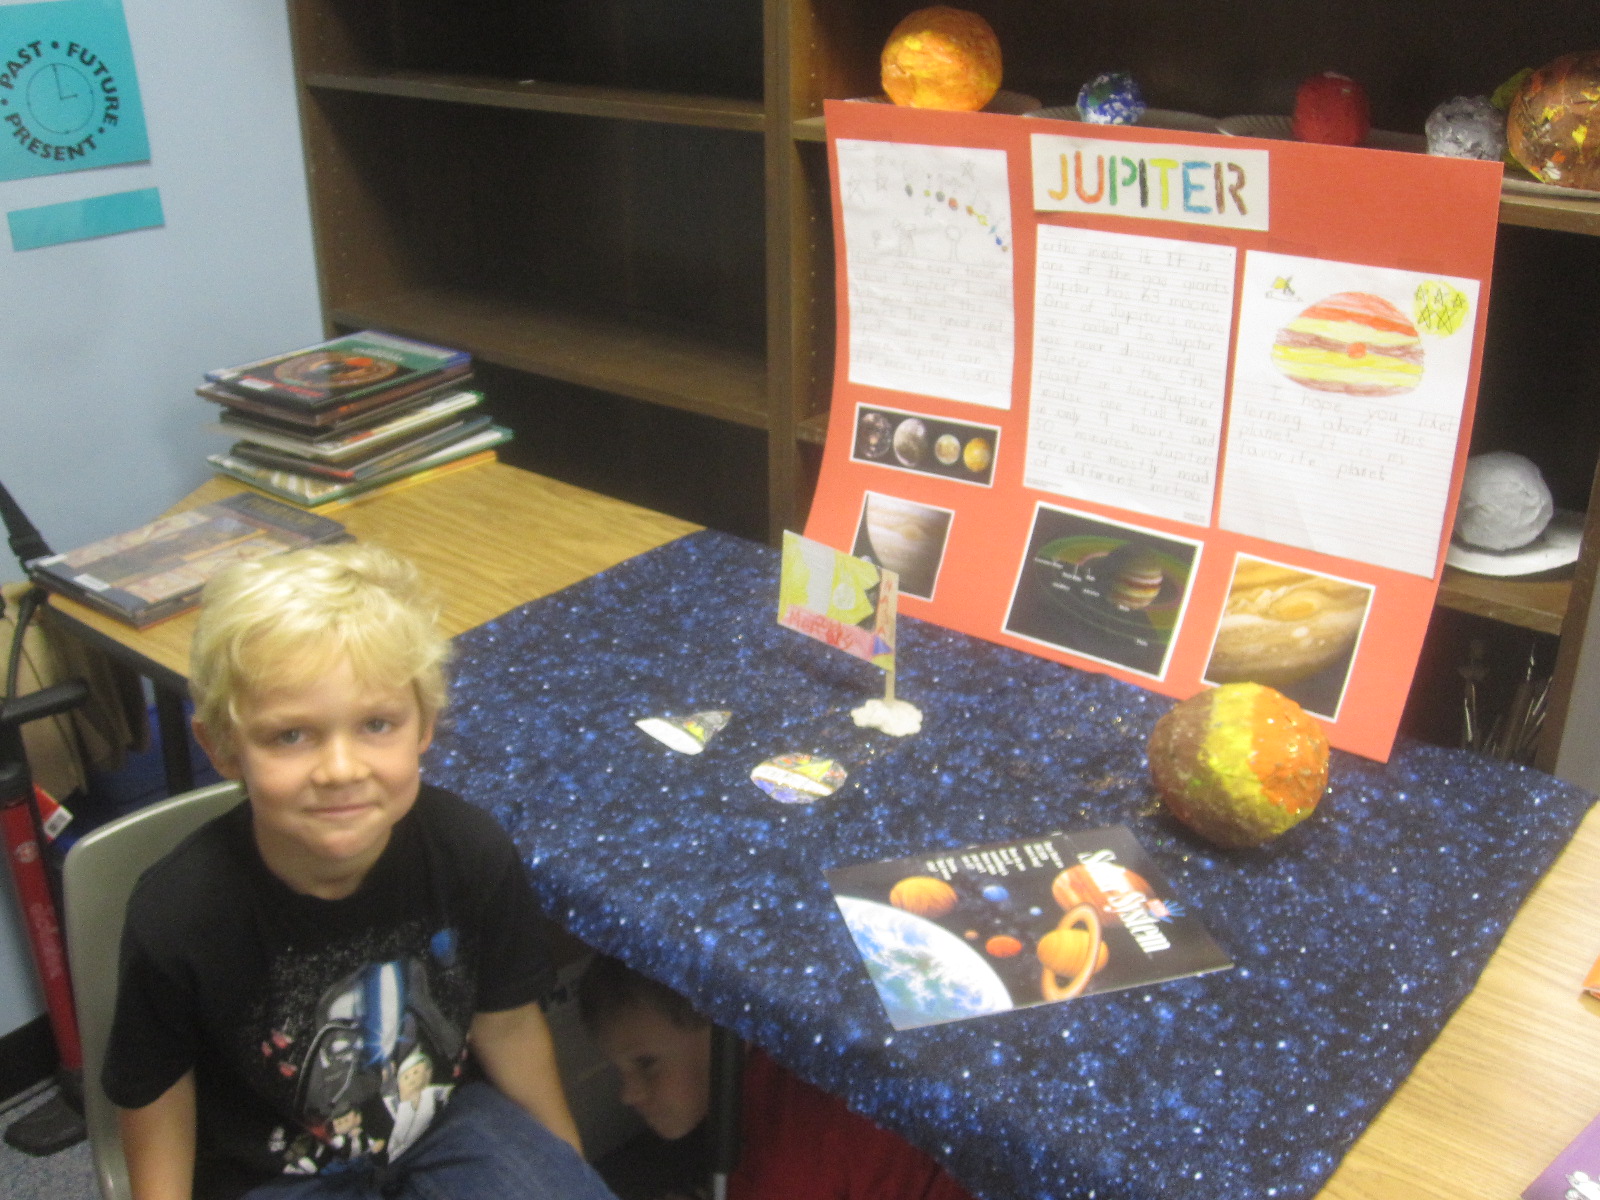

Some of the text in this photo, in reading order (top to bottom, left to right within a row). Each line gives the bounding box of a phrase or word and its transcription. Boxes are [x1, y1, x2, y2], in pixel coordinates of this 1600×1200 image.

[0, 40, 42, 90] PAST
[66, 41, 119, 127] FUTURE
[4, 112, 97, 162] PRESENT
[1048, 150, 1248, 217] JUPITER
[1270, 384, 1284, 403] I
[1302, 392, 1343, 418] hope
[1362, 408, 1400, 426] you
[1336, 461, 1388, 483] planet
[1103, 891, 1171, 953] System
